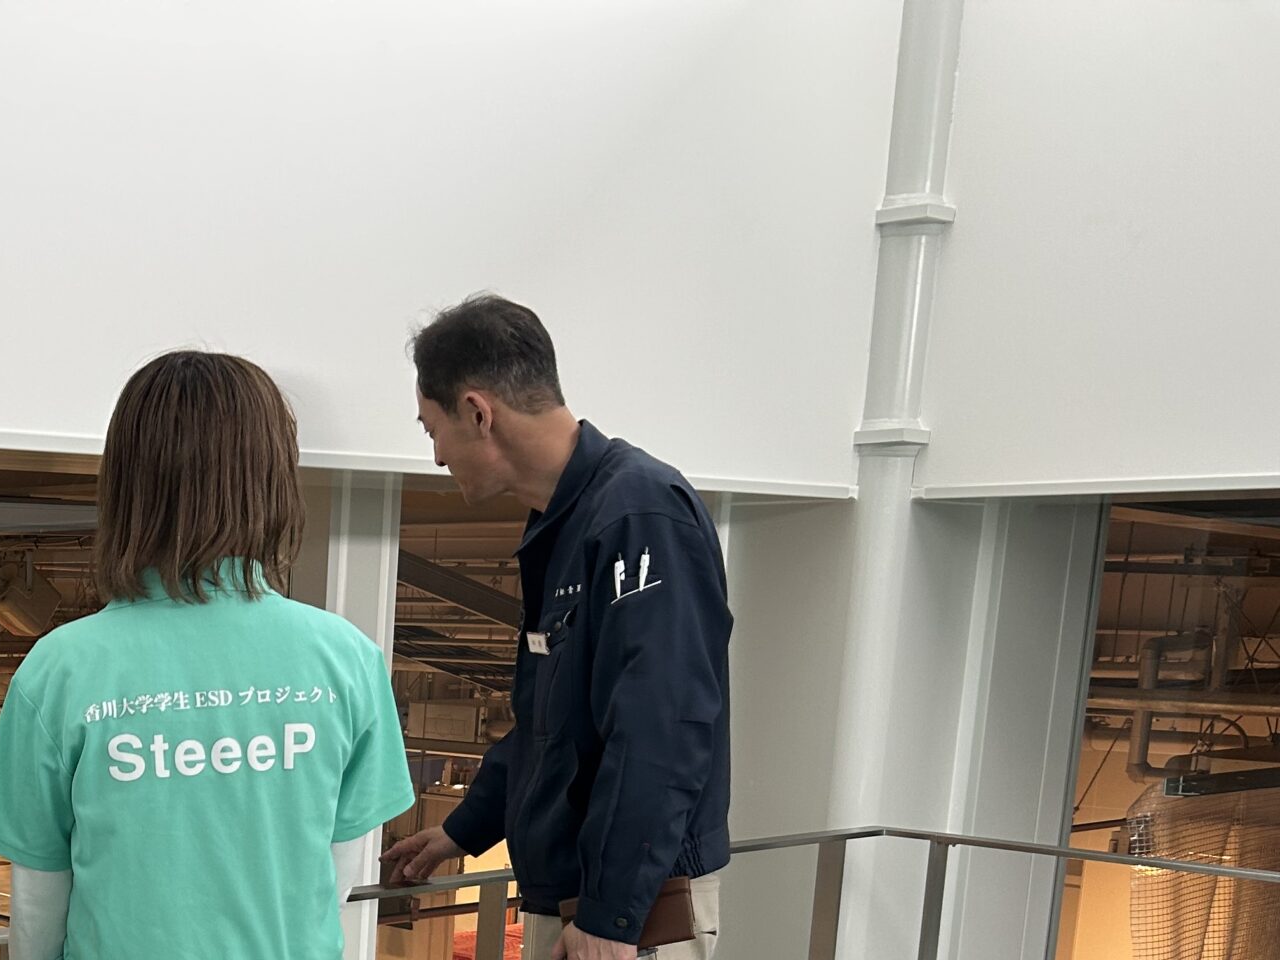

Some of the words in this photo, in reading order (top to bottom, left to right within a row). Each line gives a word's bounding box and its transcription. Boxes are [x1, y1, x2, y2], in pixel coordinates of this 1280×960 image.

[84, 691, 190, 722] 香川大学学生
[195, 690, 233, 708] ESD
[238, 685, 337, 706] プロジェクト
[107, 722, 316, 782] SteeeP
